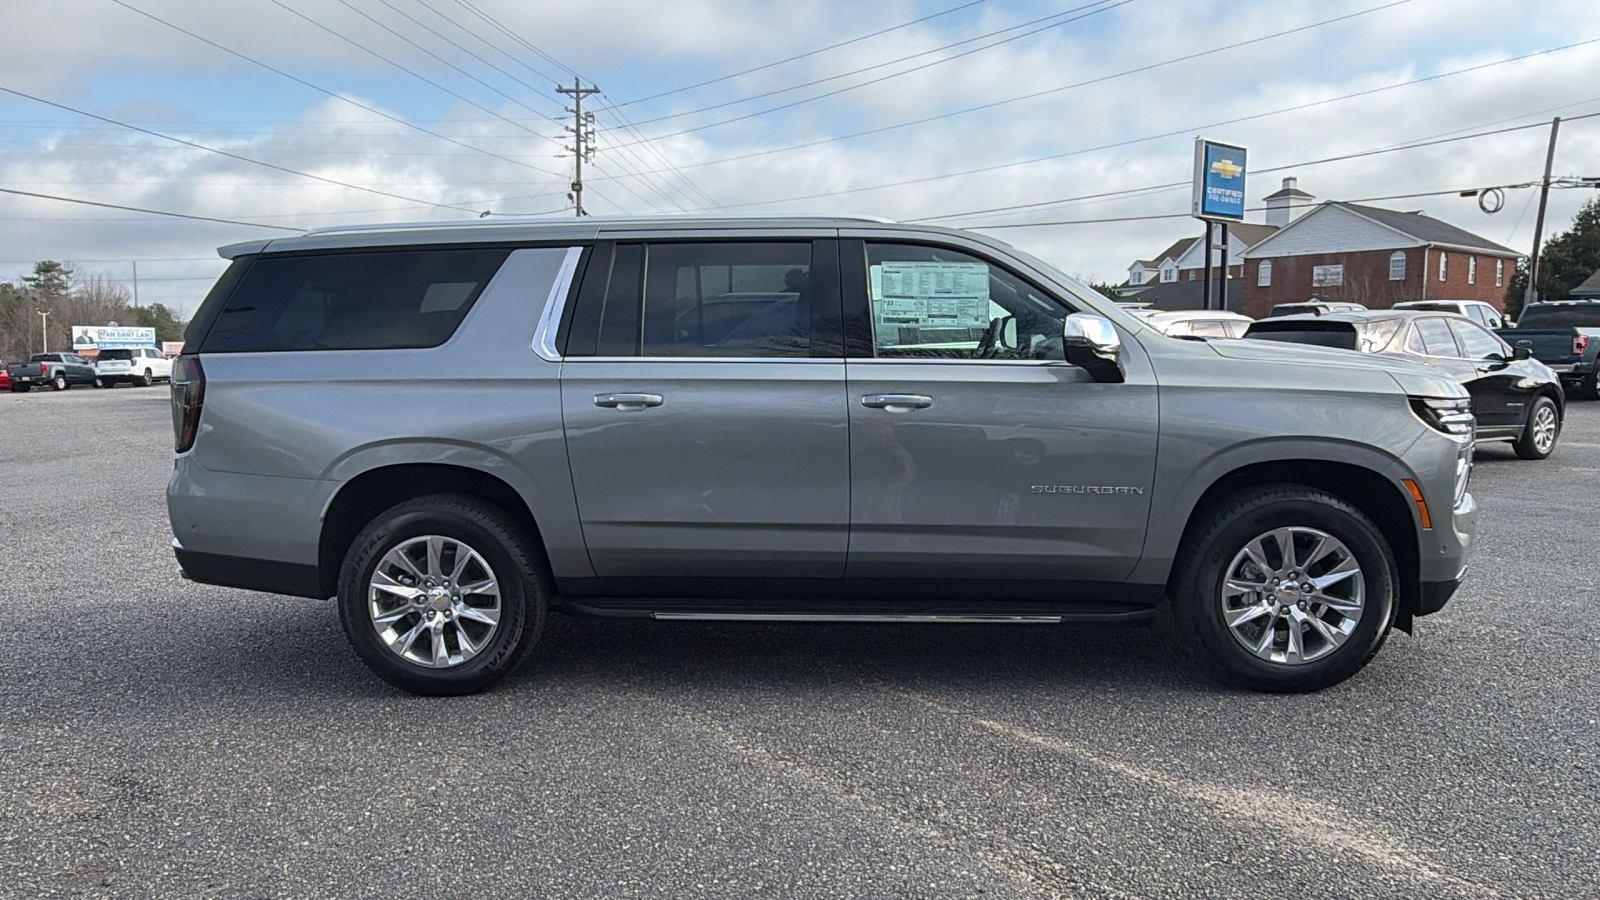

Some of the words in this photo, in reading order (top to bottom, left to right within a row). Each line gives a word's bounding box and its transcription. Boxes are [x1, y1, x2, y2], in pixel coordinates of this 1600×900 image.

[1207, 186, 1243, 198] CERTIFIED
[1208, 194, 1241, 204] PRE-OWNED
[1031, 485, 1144, 495] SUBURBAN
